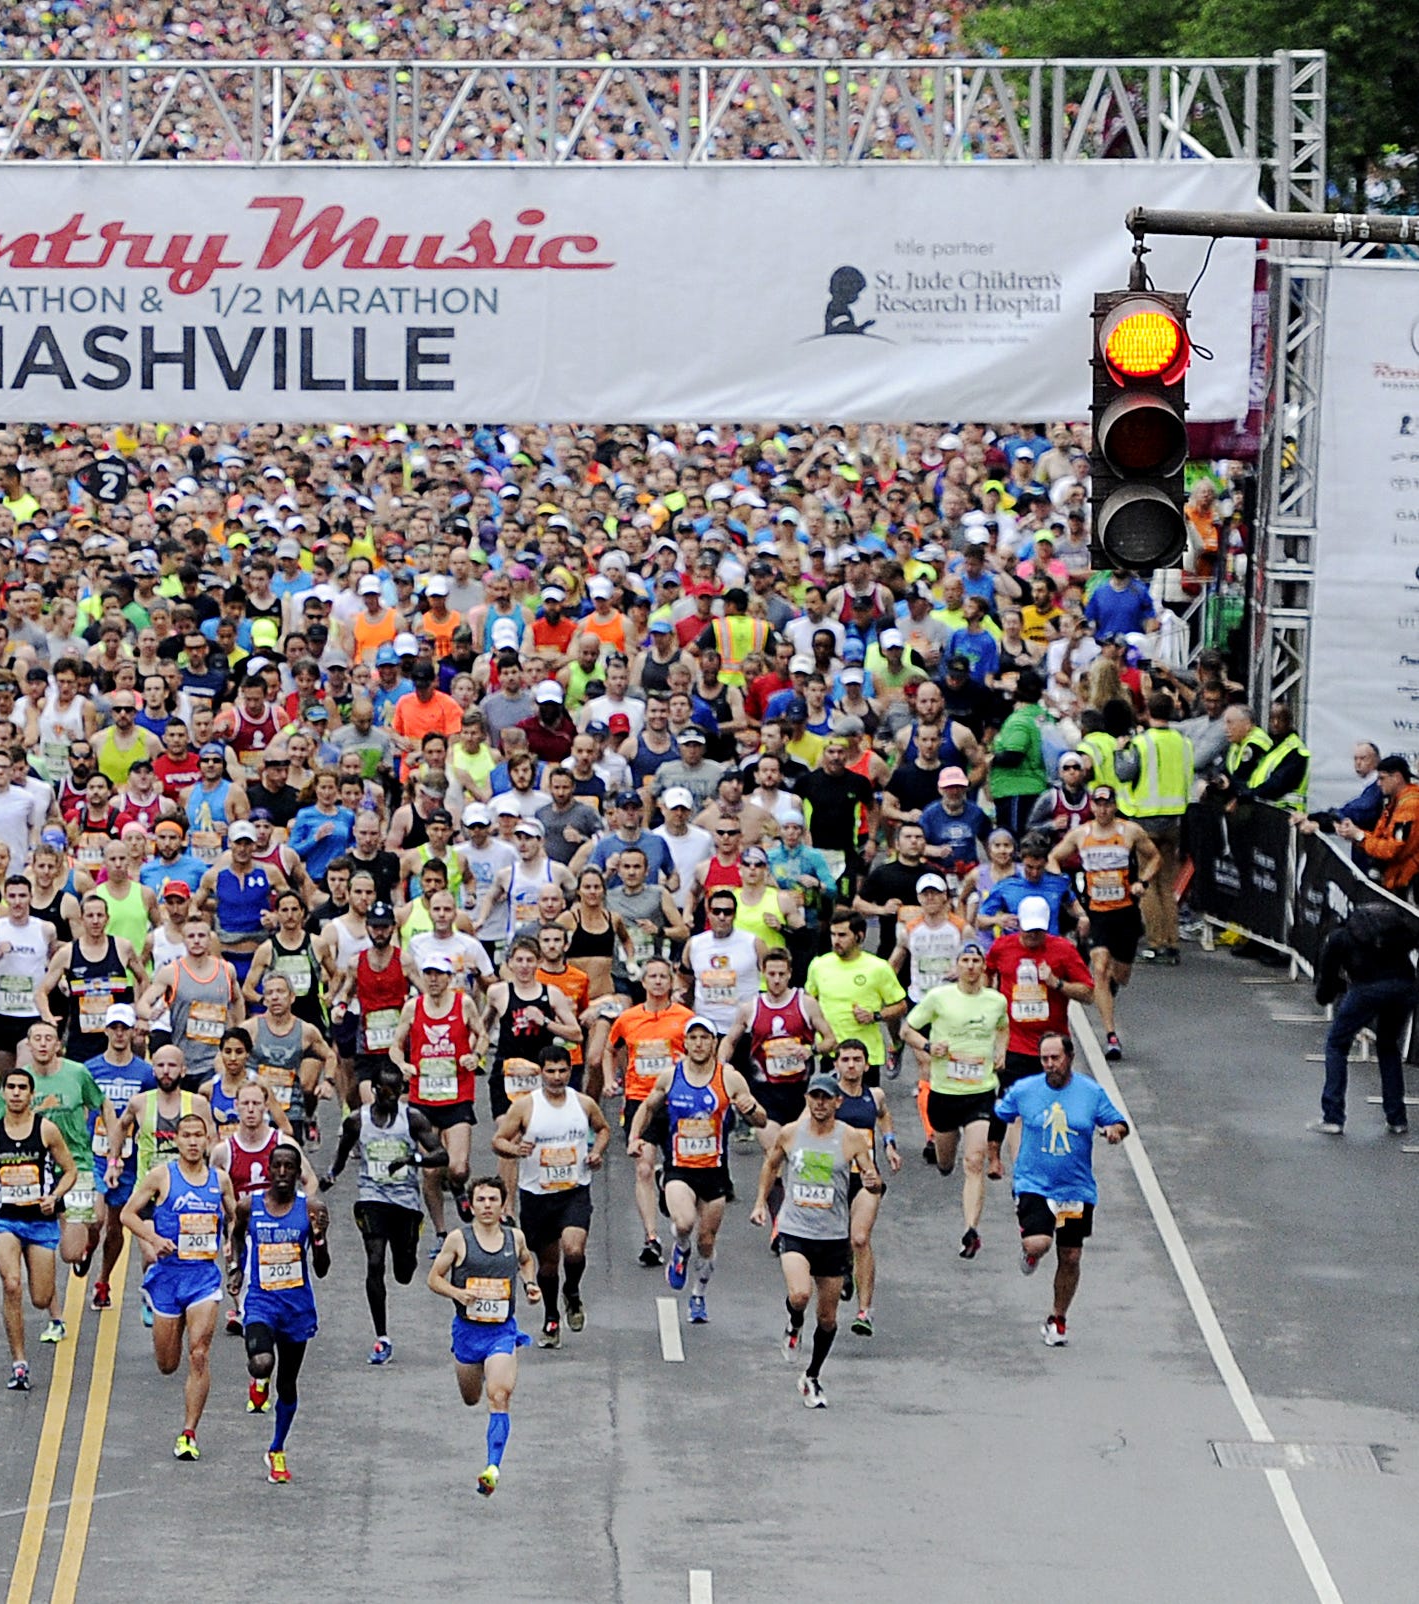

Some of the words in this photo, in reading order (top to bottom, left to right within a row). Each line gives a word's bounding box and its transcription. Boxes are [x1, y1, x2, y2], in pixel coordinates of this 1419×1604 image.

[248, 196, 616, 269] Music
[932, 242, 995, 259] partner
[875, 271, 901, 291] St.
[907, 271, 954, 293] Jude
[959, 270, 1063, 291] Children's
[140, 286, 164, 313] &
[210, 284, 263, 318] 1/2
[279, 286, 499, 315] MARATHON
[876, 293, 968, 313] Research
[975, 293, 1061, 319] Hospital
[99, 473, 119, 499] 2
[9, 1186, 31, 1198] 204
[269, 1265, 292, 1278] 202
[476, 1301, 499, 1313] 205
